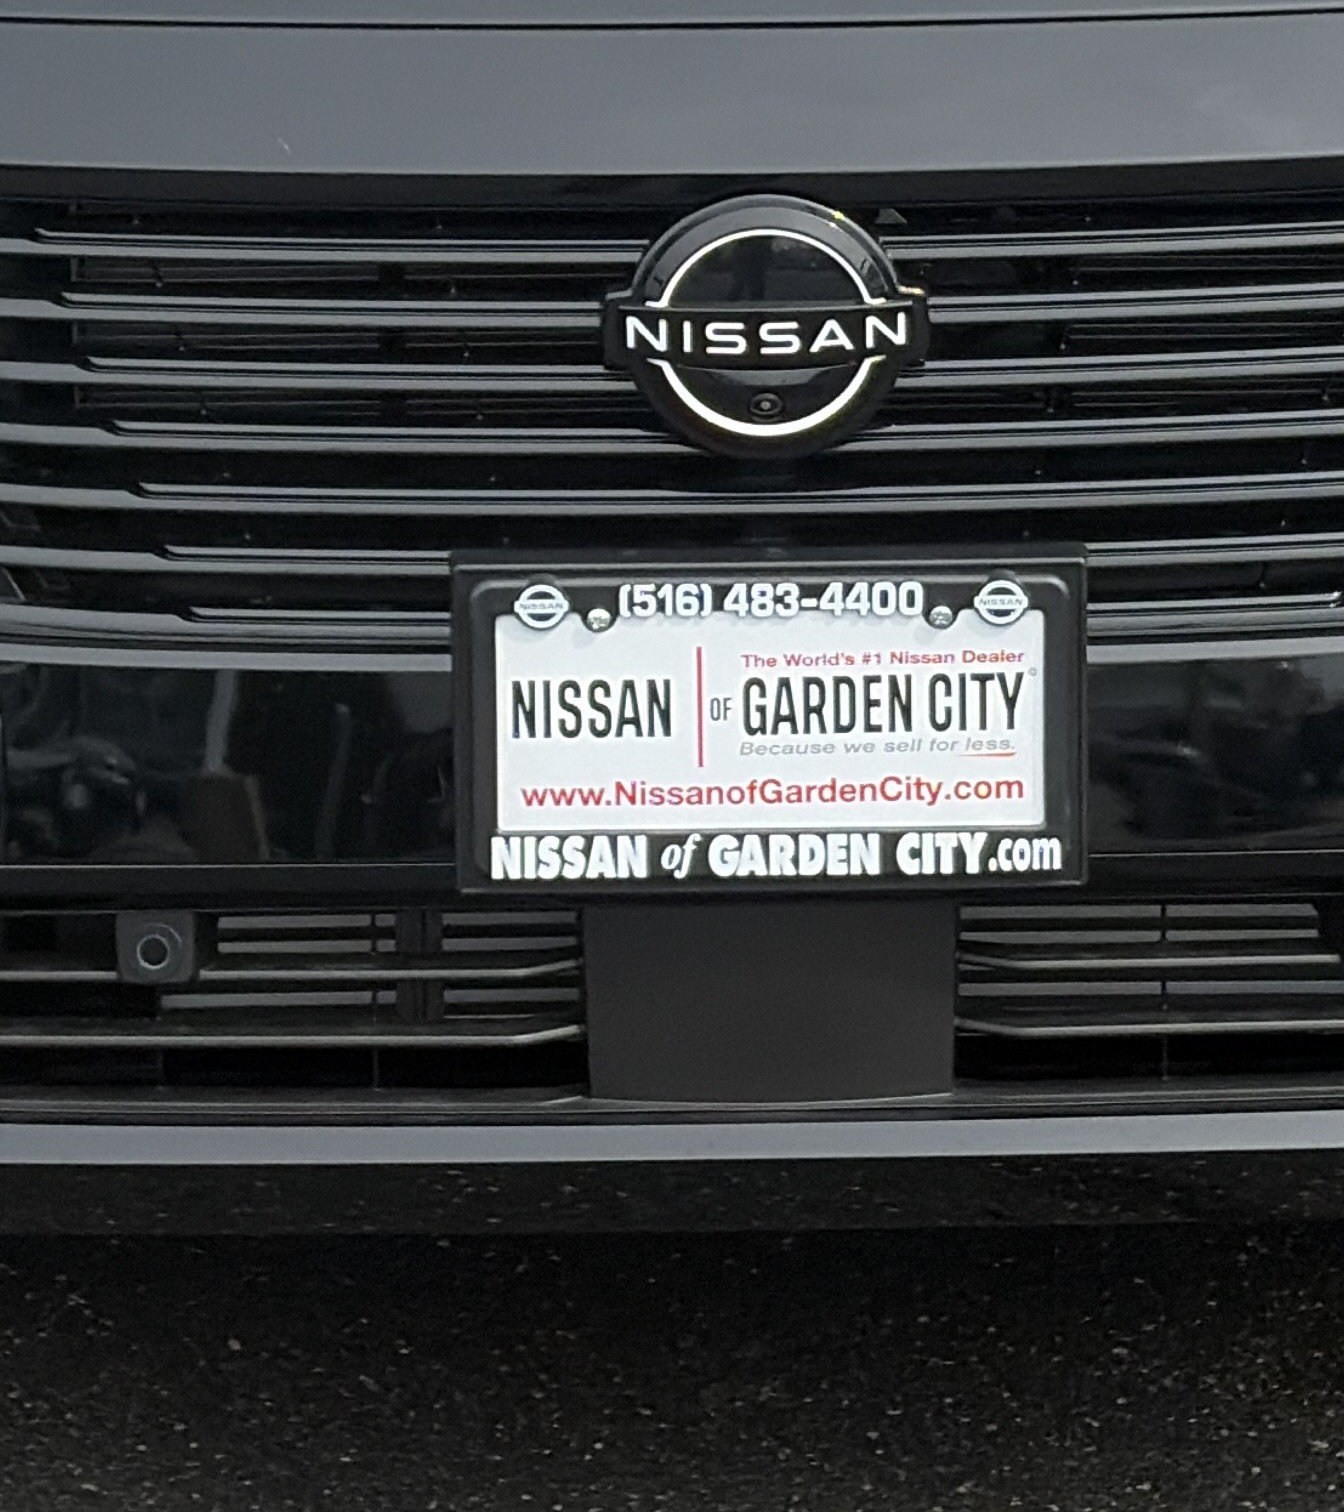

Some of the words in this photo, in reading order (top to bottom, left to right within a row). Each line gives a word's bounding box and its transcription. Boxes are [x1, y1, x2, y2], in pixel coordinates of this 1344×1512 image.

[625, 311, 907, 355] NISSAN
[519, 602, 564, 610] NISSAN
[618, 583, 712, 618] (516)
[723, 581, 924, 618] 483-4400
[978, 597, 1023, 606] NISSAN
[741, 654, 777, 667] The
[785, 652, 855, 666] World's
[862, 652, 881, 665] #1
[890, 651, 955, 664] Nissan
[962, 650, 1024, 663] Dealer
[512, 679, 671, 738] NISSAN
[710, 697, 732, 721] OF
[743, 674, 912, 736] GARDEN
[928, 672, 1024, 732] CITY
[740, 741, 835, 756] Because
[844, 742, 875, 753] we
[884, 738, 921, 753] sell
[930, 738, 958, 751] for
[965, 738, 1015, 751] less.
[521, 776, 1024, 806] www.NissanofGardenCity.com
[491, 835, 648, 879] NISSAN
[661, 833, 704, 879] of
[708, 833, 880, 877] GARDEN
[896, 832, 1062, 875] CITY.com
